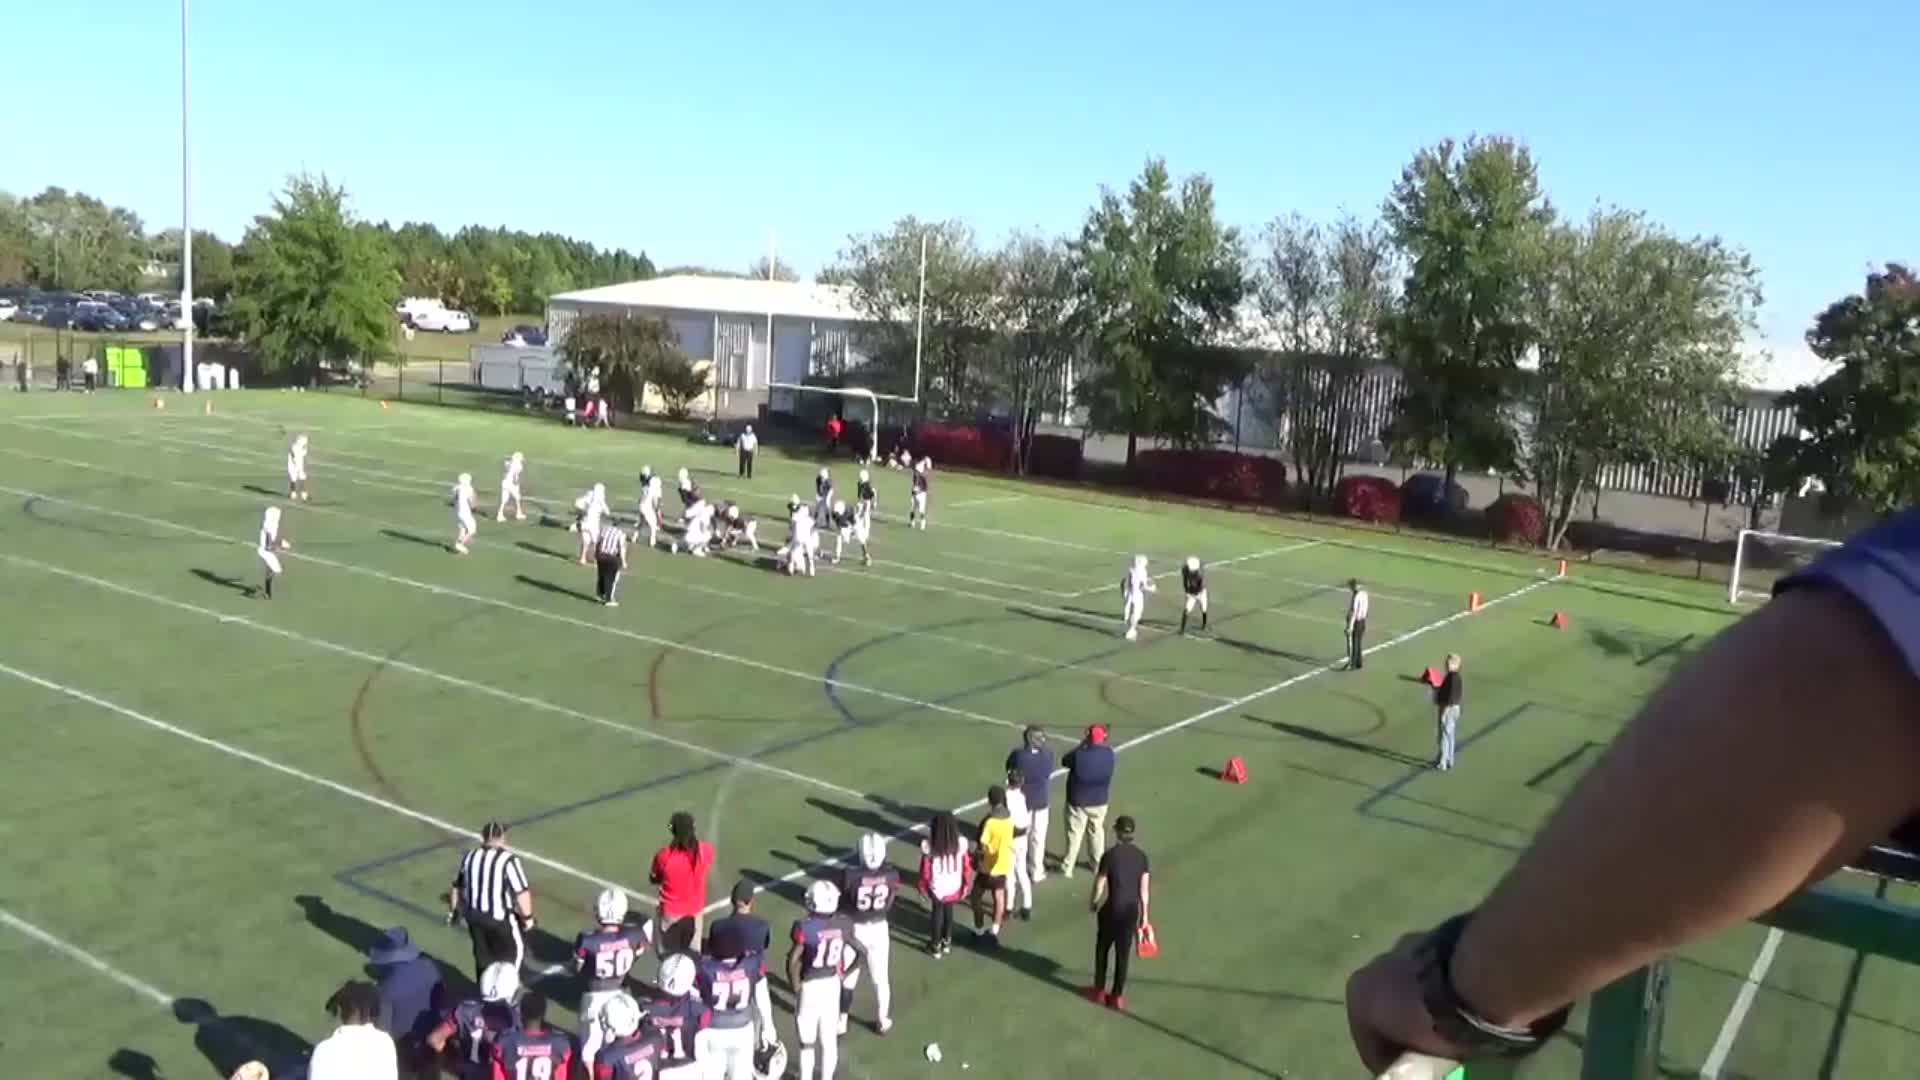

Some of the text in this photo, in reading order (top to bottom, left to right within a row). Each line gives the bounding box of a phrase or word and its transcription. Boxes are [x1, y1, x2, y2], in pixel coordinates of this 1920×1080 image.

[857, 884, 889, 911] 52
[811, 937, 843, 967] 18
[711, 978, 750, 1011] 77
